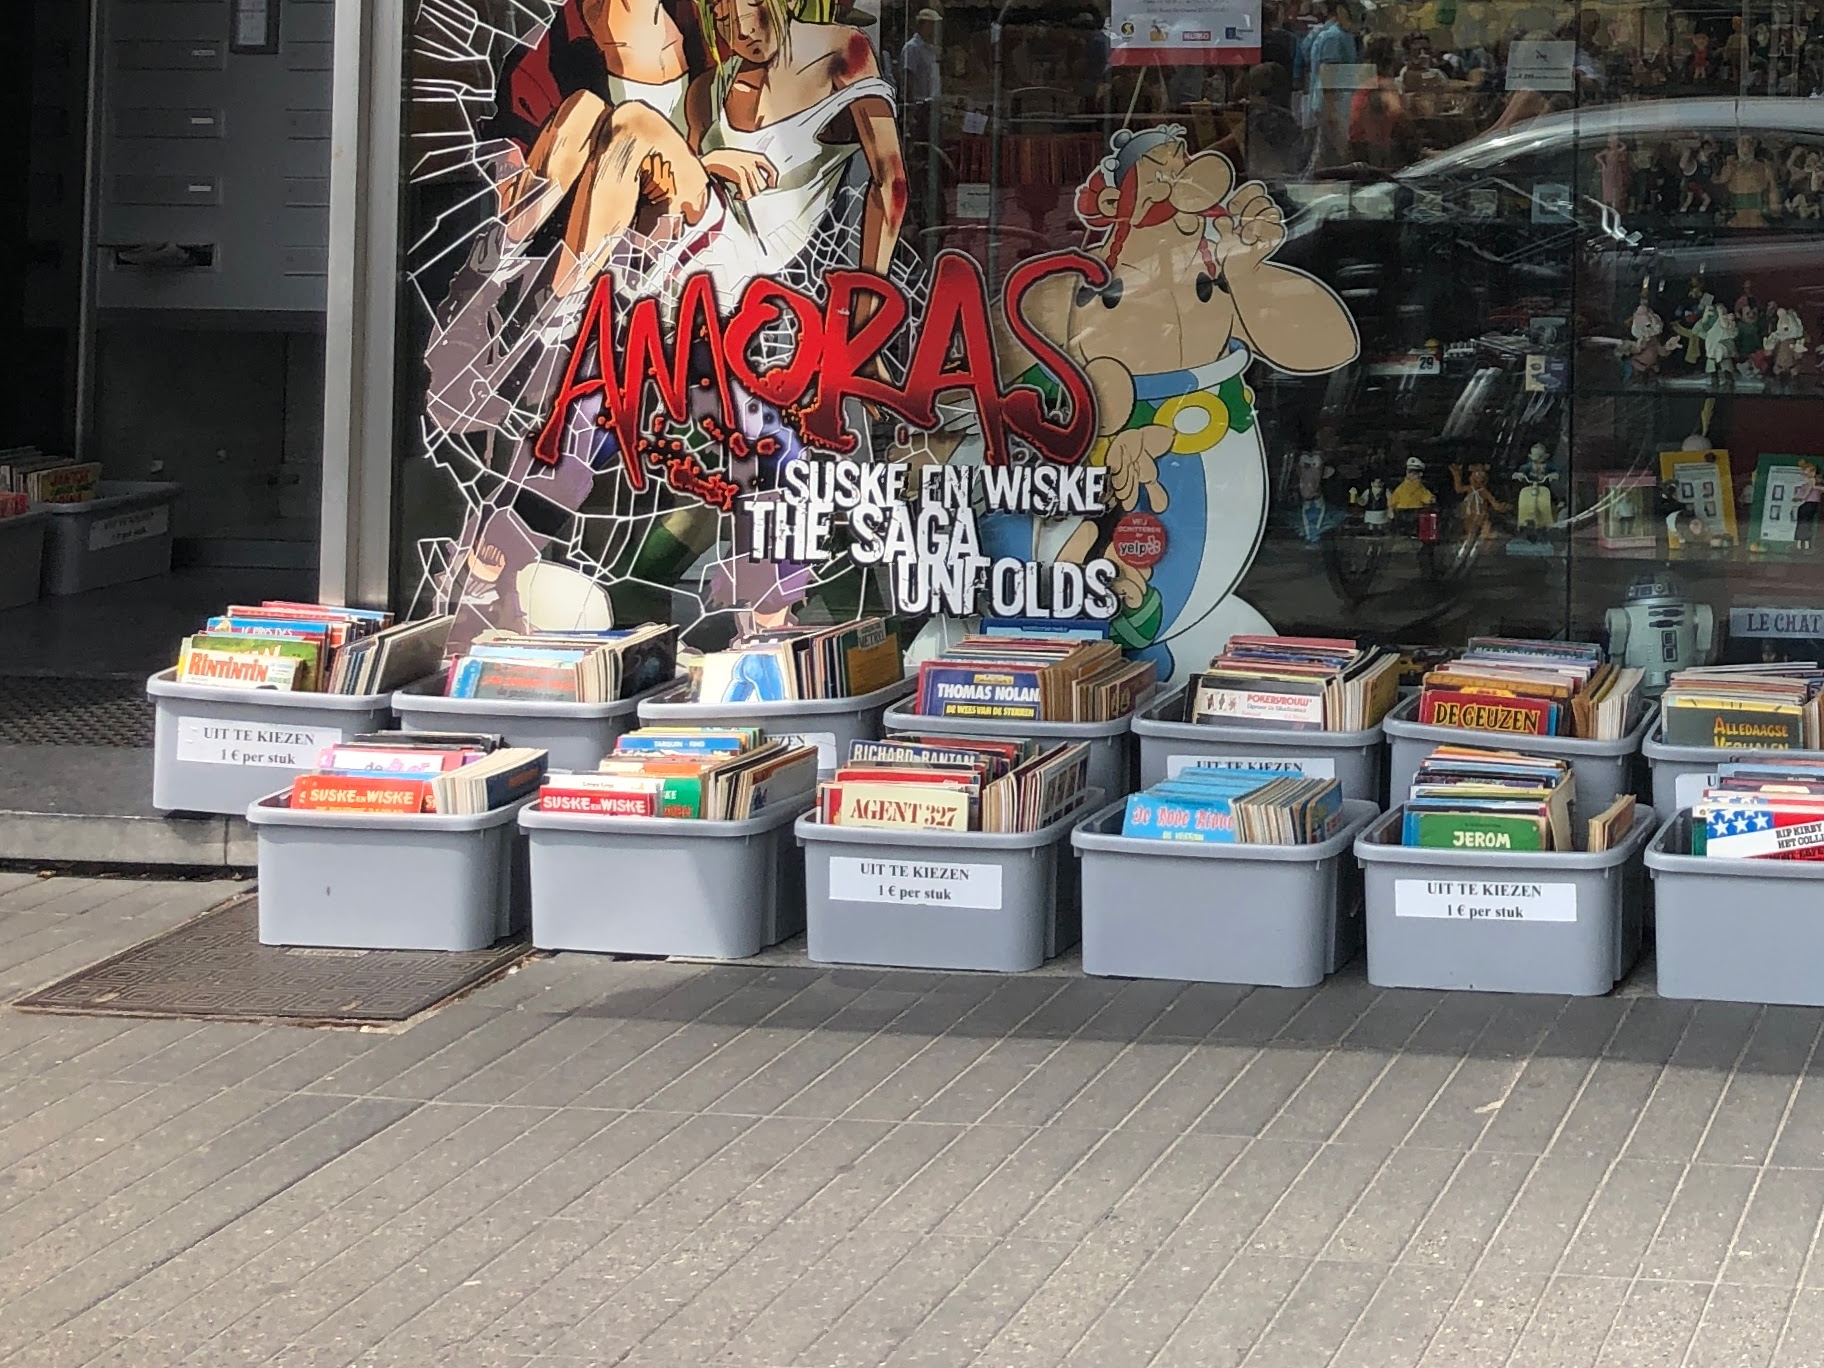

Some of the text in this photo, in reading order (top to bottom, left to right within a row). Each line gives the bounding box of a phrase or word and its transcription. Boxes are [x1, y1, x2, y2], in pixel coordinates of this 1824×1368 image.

[533, 249, 1111, 492] AMORAS
[1419, 356, 1434, 371] 29
[783, 458, 1109, 515] SUSKE EN WISKE
[744, 500, 982, 566] THE SAGA
[1119, 540, 1147, 556] yelp
[898, 554, 1120, 619] UNFOLDS
[1747, 613, 1823, 634] LE CHAT
[937, 683, 1041, 702] THOMAS NOLAN
[1434, 700, 1542, 733] DE GEUZEN
[203, 726, 315, 746] UIT TE KIEZEN
[1713, 716, 1789, 738] ALLEDAAGSE
[220, 749, 296, 767] 1 € per stuk
[310, 788, 358, 804] SUSKE
[366, 790, 414, 805] WISKE
[543, 795, 591, 811] SUSKE
[600, 798, 645, 814] WISKE
[850, 797, 958, 828] AGENT 327
[1452, 830, 1511, 849] JEROM
[1775, 828, 1793, 839] RIP
[1793, 822, 1823, 836] KIRBY
[1777, 838, 1797, 849] HET
[860, 863, 970, 881] UIT TE KIEZEN
[878, 884, 952, 901] 1 € per stuk
[1427, 882, 1542, 898] UIT TE KIEZEN
[1447, 904, 1524, 920] 1 € per stuk
